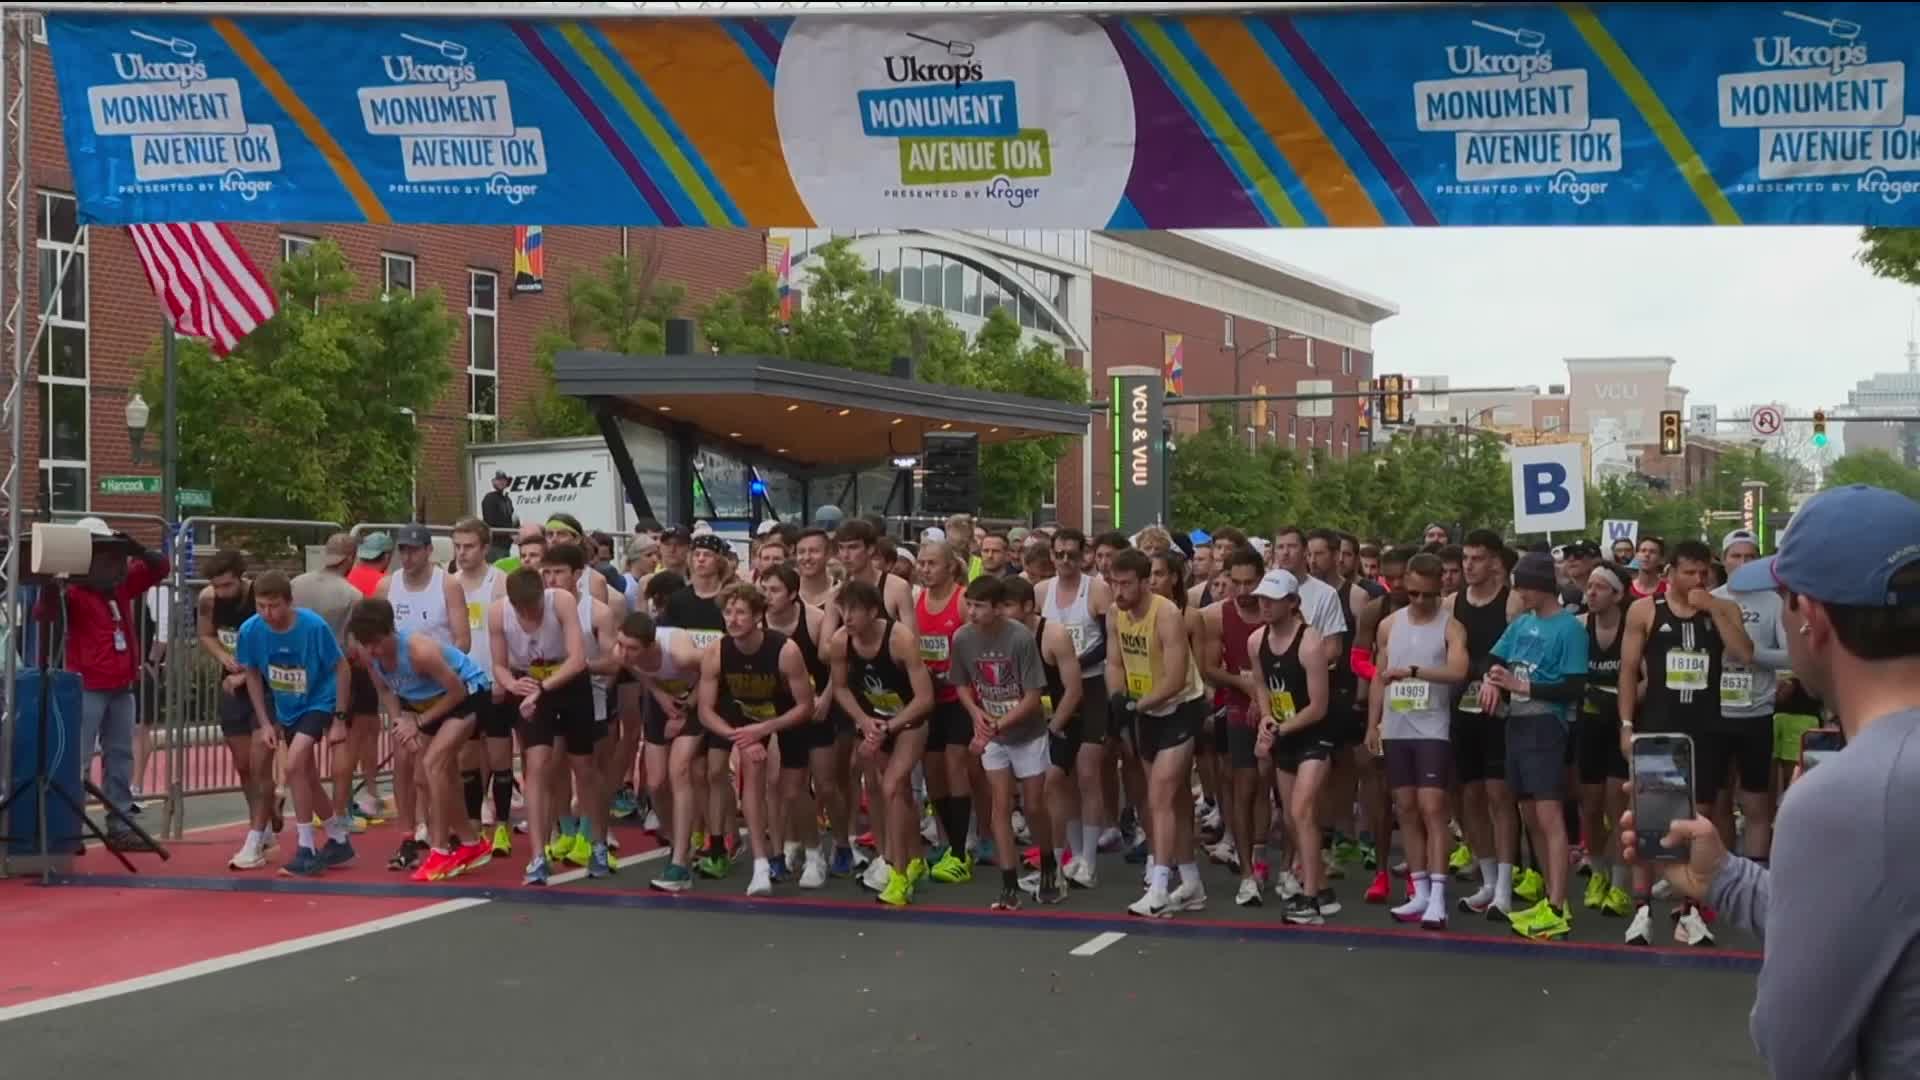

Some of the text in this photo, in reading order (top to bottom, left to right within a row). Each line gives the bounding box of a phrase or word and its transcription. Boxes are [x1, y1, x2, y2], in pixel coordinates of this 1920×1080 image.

[112, 53, 207, 88] Ukrop's
[1445, 46, 1552, 81] Ukrop's
[1753, 36, 1868, 75] Ukrop's
[382, 56, 476, 91] Ukrop's
[884, 56, 983, 89] Ukrop's
[101, 93, 230, 125] MONUMENT
[370, 95, 496, 126] MONUMENT
[869, 94, 1003, 128] MONUMENT
[1426, 85, 1574, 121] MONUMENT
[1730, 79, 1889, 117] MONUMENT
[143, 137, 228, 165] AVENUE
[412, 139, 495, 167] AVENUE
[908, 141, 996, 171] AVENUE
[1465, 133, 1561, 164] AVENUE
[1769, 131, 1873, 162] AVENUE
[119, 169, 272, 200] PRESENTED BY Kroger
[389, 173, 538, 204] PRESENTED BY Kroger
[884, 177, 1040, 208] PRESENTED BY Kroger
[1437, 171, 1608, 205] PRESENTED BY Kroger
[1736, 169, 1920, 204] PRESENTED BY Kroger
[1592, 383, 1639, 400] VCU
[1131, 384, 1148, 486] VCU & VUU
[508, 470, 598, 493] ENSKE
[1523, 462, 1570, 516] B
[516, 493, 577, 505] Truck Rental
[1608, 521, 1633, 540] W
[1395, 685, 1425, 697] 14909
